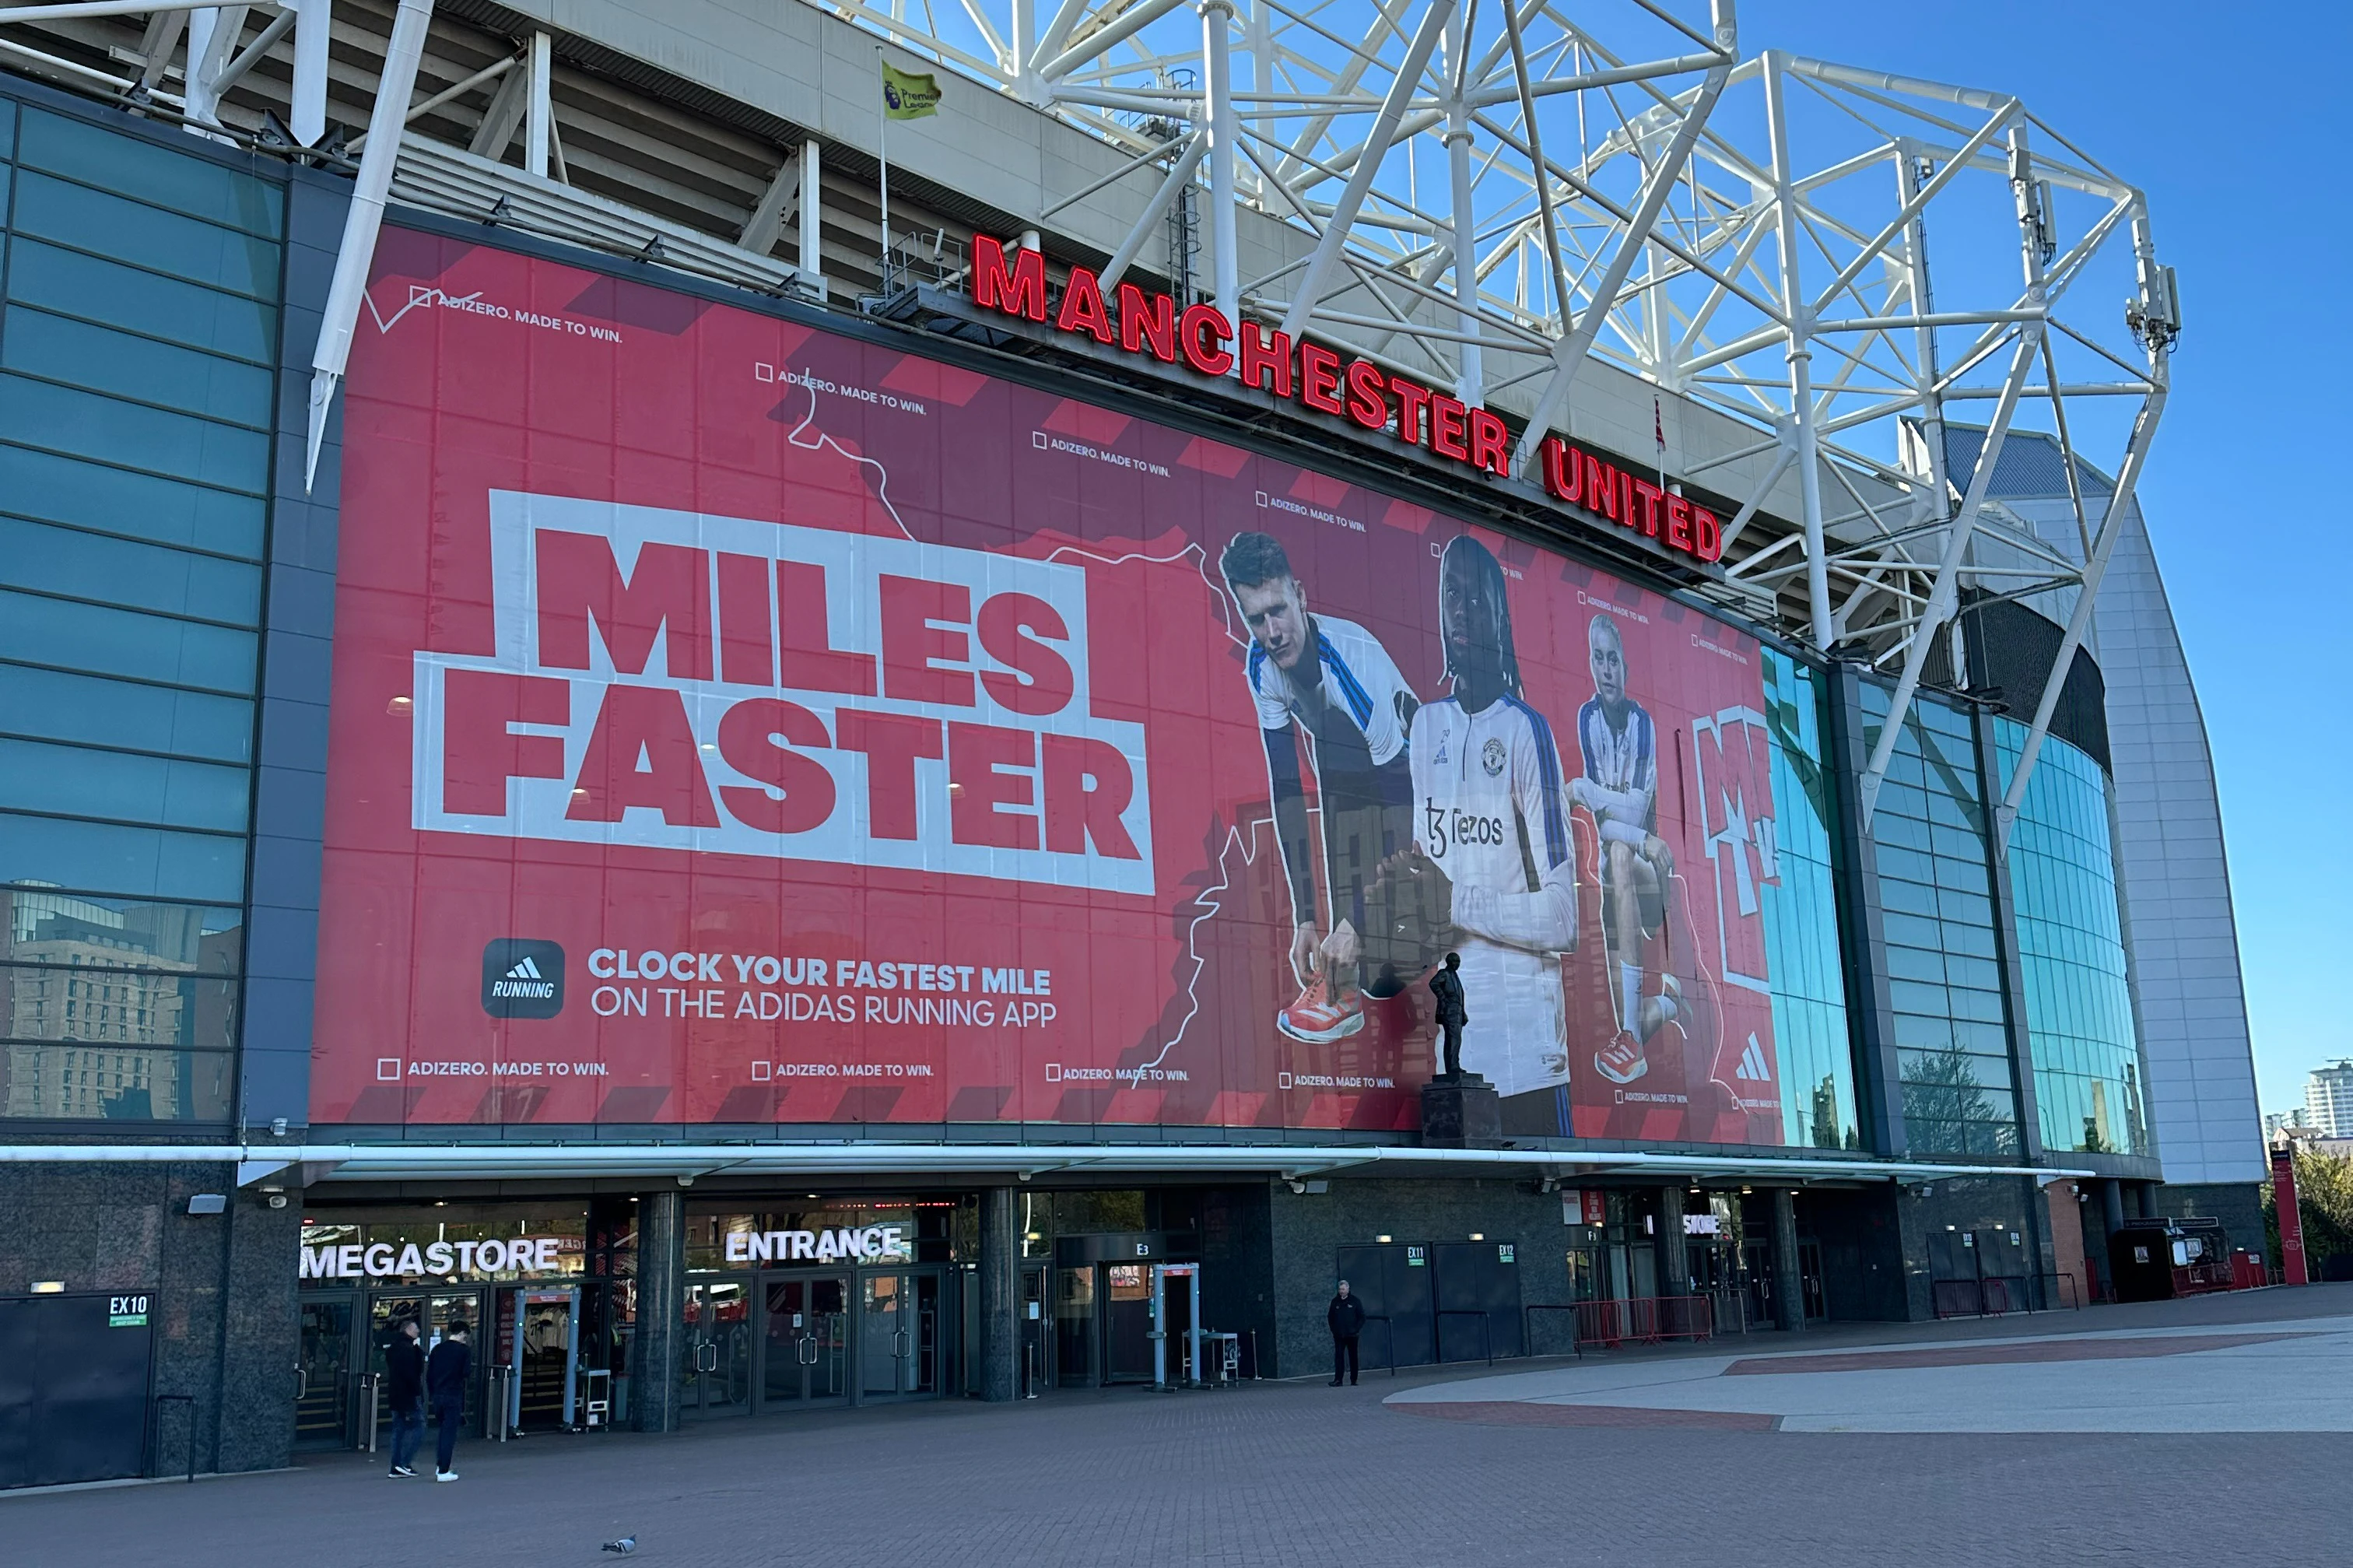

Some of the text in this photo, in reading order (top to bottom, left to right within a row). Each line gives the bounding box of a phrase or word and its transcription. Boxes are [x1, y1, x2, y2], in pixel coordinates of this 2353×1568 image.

[438, 296, 623, 343] ADIZERO. MADE TO WIN.
[778, 370, 927, 416] ADIZERO. MADE TO WIN.
[971, 233, 1721, 563] MANCHESTER UNITED
[1050, 439, 1171, 478] ADIZERO. MADE TO WIN.
[1271, 497, 1366, 532] ADIZERO. MADE TO WIN.
[535, 528, 1074, 716] MILES
[444, 668, 1143, 861] FASTER
[1451, 808, 1503, 846] Tezos
[492, 980, 555, 998] RUNNING
[587, 948, 1050, 995] CLOCK YOUR FASTEST MILE
[591, 986, 1057, 1028] ON THE ADIDAS RUNNING APP
[408, 1061, 609, 1076] ADIZERO. MADE TO WIN.
[776, 1064, 934, 1076] ADIZERO. MADE TO WIN.
[1063, 1068, 1190, 1081] ADIZERO. MADE TO WIN.
[1295, 1075, 1395, 1089] ADIZERO. MADE TO WIN.
[299, 1238, 559, 1279] MEGASTORE
[725, 1227, 902, 1261] ENTRANCE
[1137, 1244, 1148, 1256] E3
[1408, 1247, 1424, 1258] EX11
[1499, 1244, 1513, 1256] EX12
[110, 1296, 147, 1314] EX10
